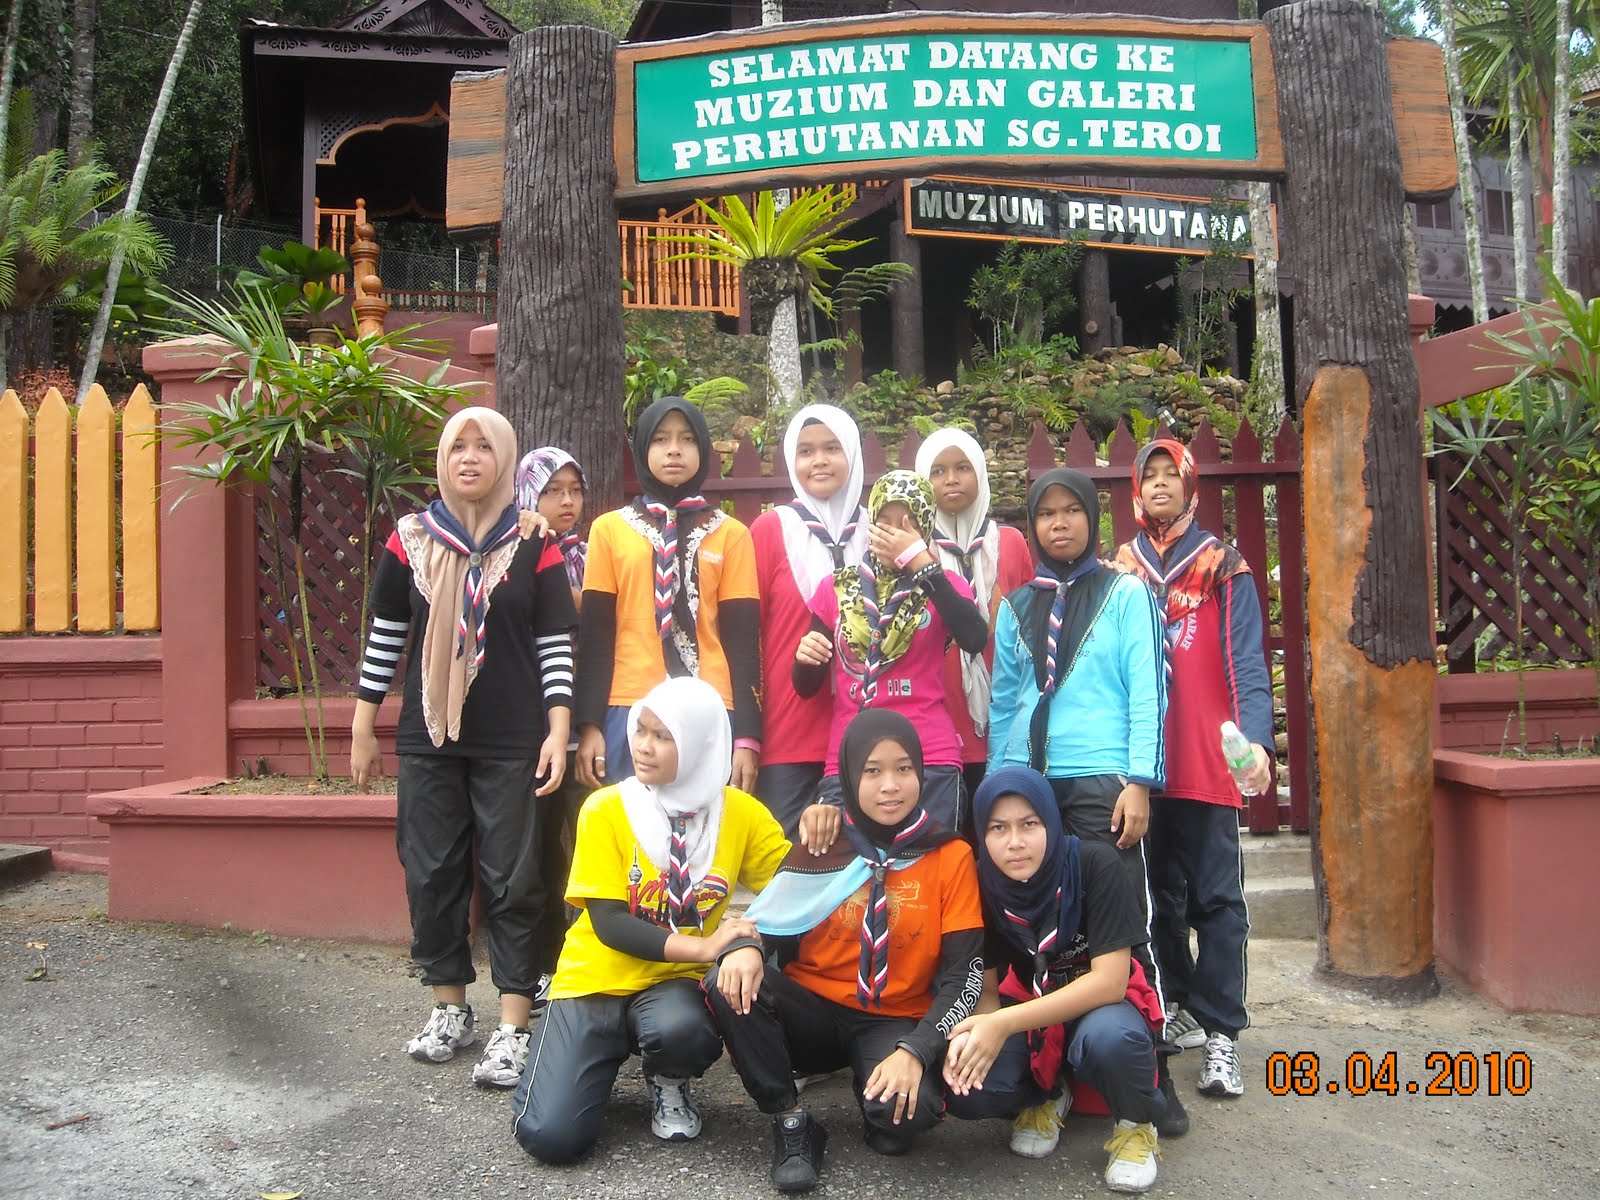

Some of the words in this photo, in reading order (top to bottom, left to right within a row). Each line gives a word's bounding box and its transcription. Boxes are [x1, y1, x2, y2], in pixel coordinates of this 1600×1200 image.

[708, 44, 910, 88] SELAMAT
[928, 41, 1098, 70] DATANG
[1117, 43, 1174, 73] KE
[694, 82, 888, 129] MUZIUM
[912, 78, 1007, 108] DAN
[1027, 79, 1196, 112] GALERI
[672, 118, 985, 171] PERHUTANAN
[1007, 119, 1222, 152] SG.TEROI
[918, 189, 1044, 227] MUZIUM
[1068, 200, 1249, 242] PERHUTANA
